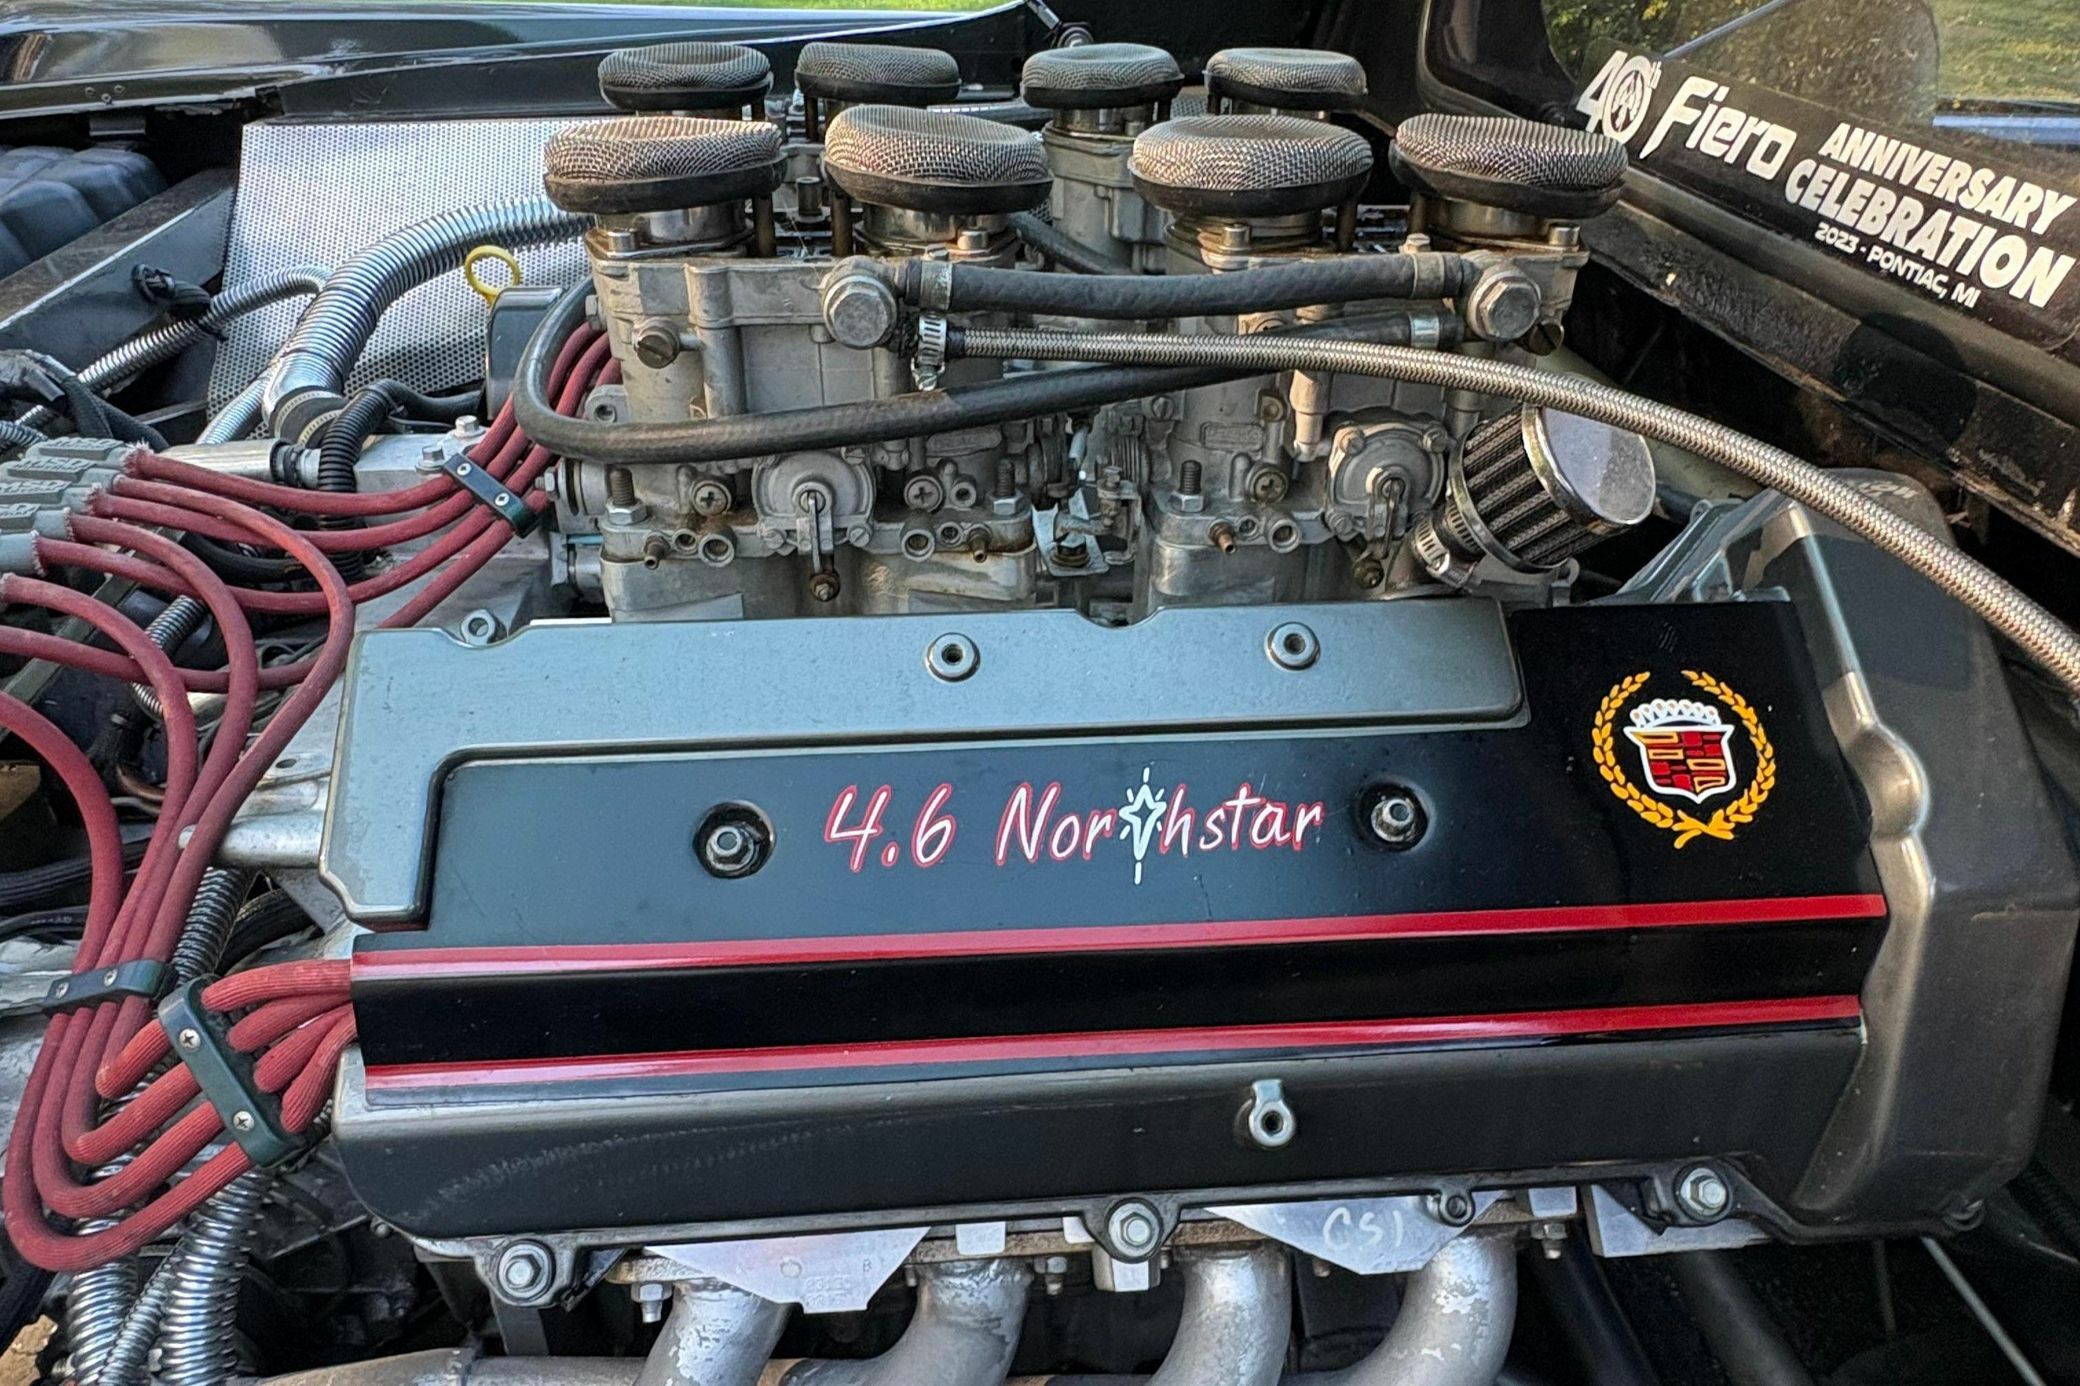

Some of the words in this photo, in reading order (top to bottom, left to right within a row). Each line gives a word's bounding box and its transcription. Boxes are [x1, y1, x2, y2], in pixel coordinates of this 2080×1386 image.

[1639, 76, 1797, 181] Fiero
[1818, 122, 2078, 235] ANNIVERSARY
[1785, 158, 2077, 308] CELEBRATION
[1814, 222, 1860, 254] 2023
[1867, 245, 1949, 299] PONTIAC,
[1951, 282, 1982, 309] MI
[824, 782, 955, 872] 4.6
